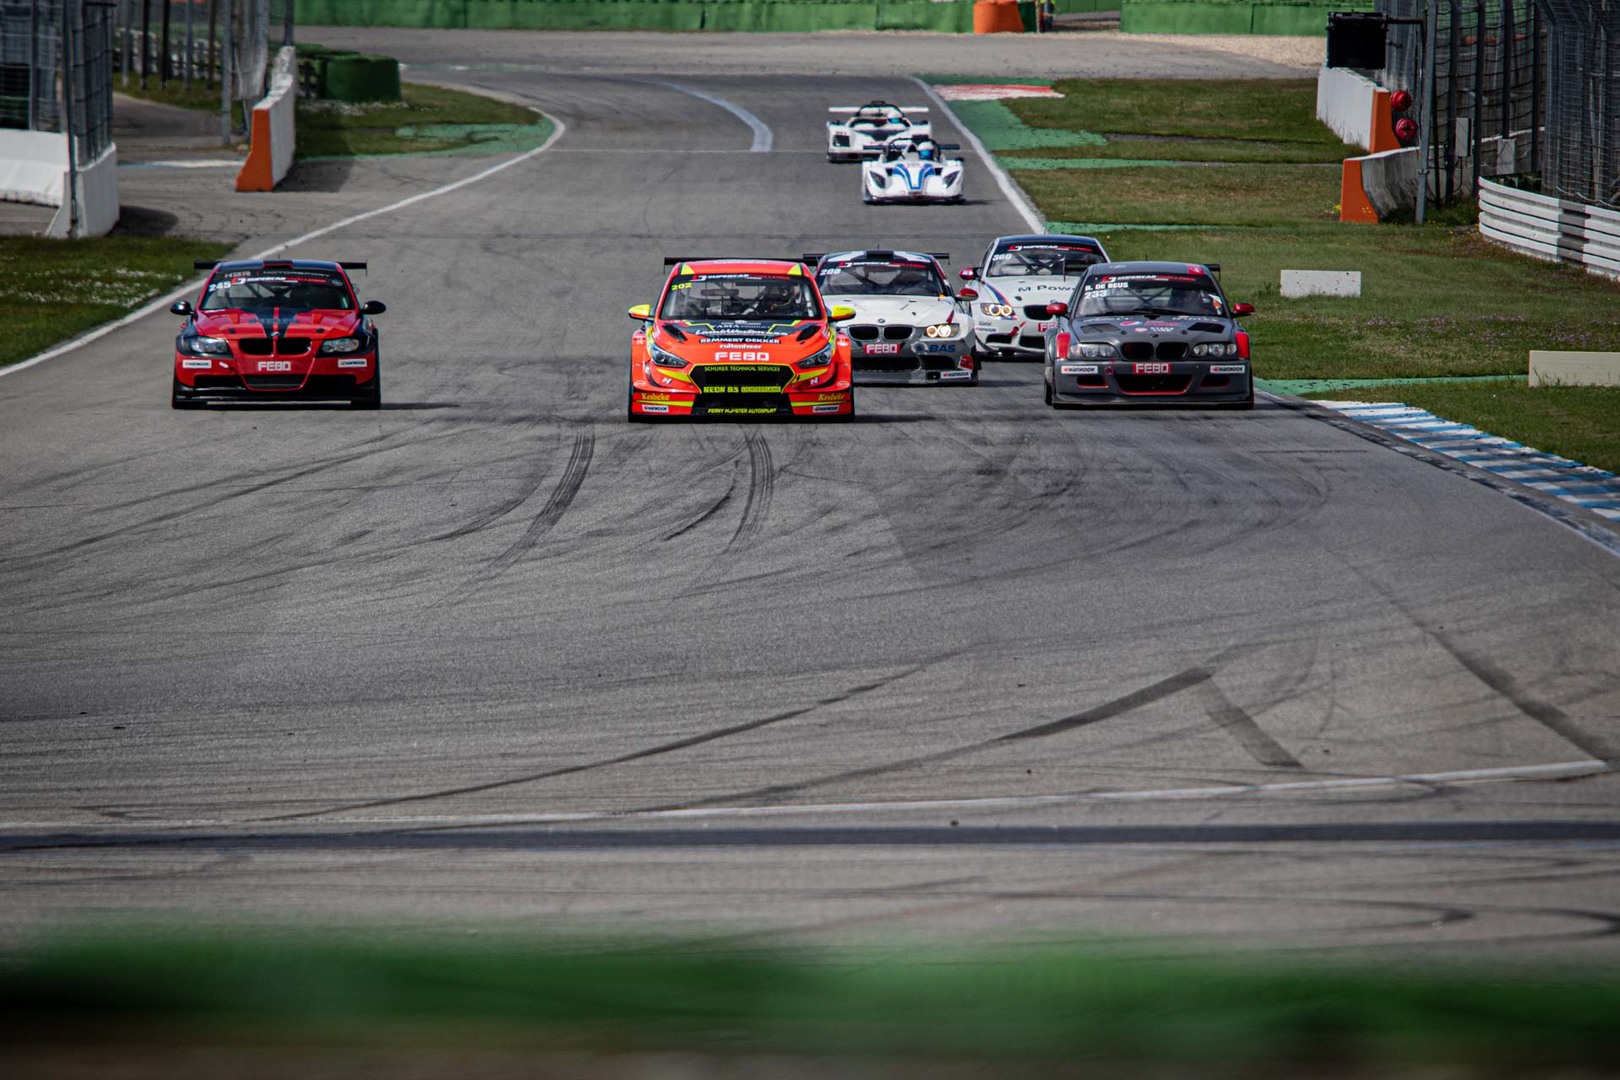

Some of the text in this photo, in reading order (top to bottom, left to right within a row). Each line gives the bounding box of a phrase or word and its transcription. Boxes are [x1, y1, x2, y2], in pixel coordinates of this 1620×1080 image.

[208, 280, 231, 292] 245
[671, 282, 693, 291] 202
[1084, 290, 1108, 299] 233
[866, 343, 898, 354] FEBO
[929, 344, 956, 353] BAS
[715, 351, 770, 362] FEBO
[258, 360, 292, 372] FEBO
[1136, 363, 1169, 374] FEBO
